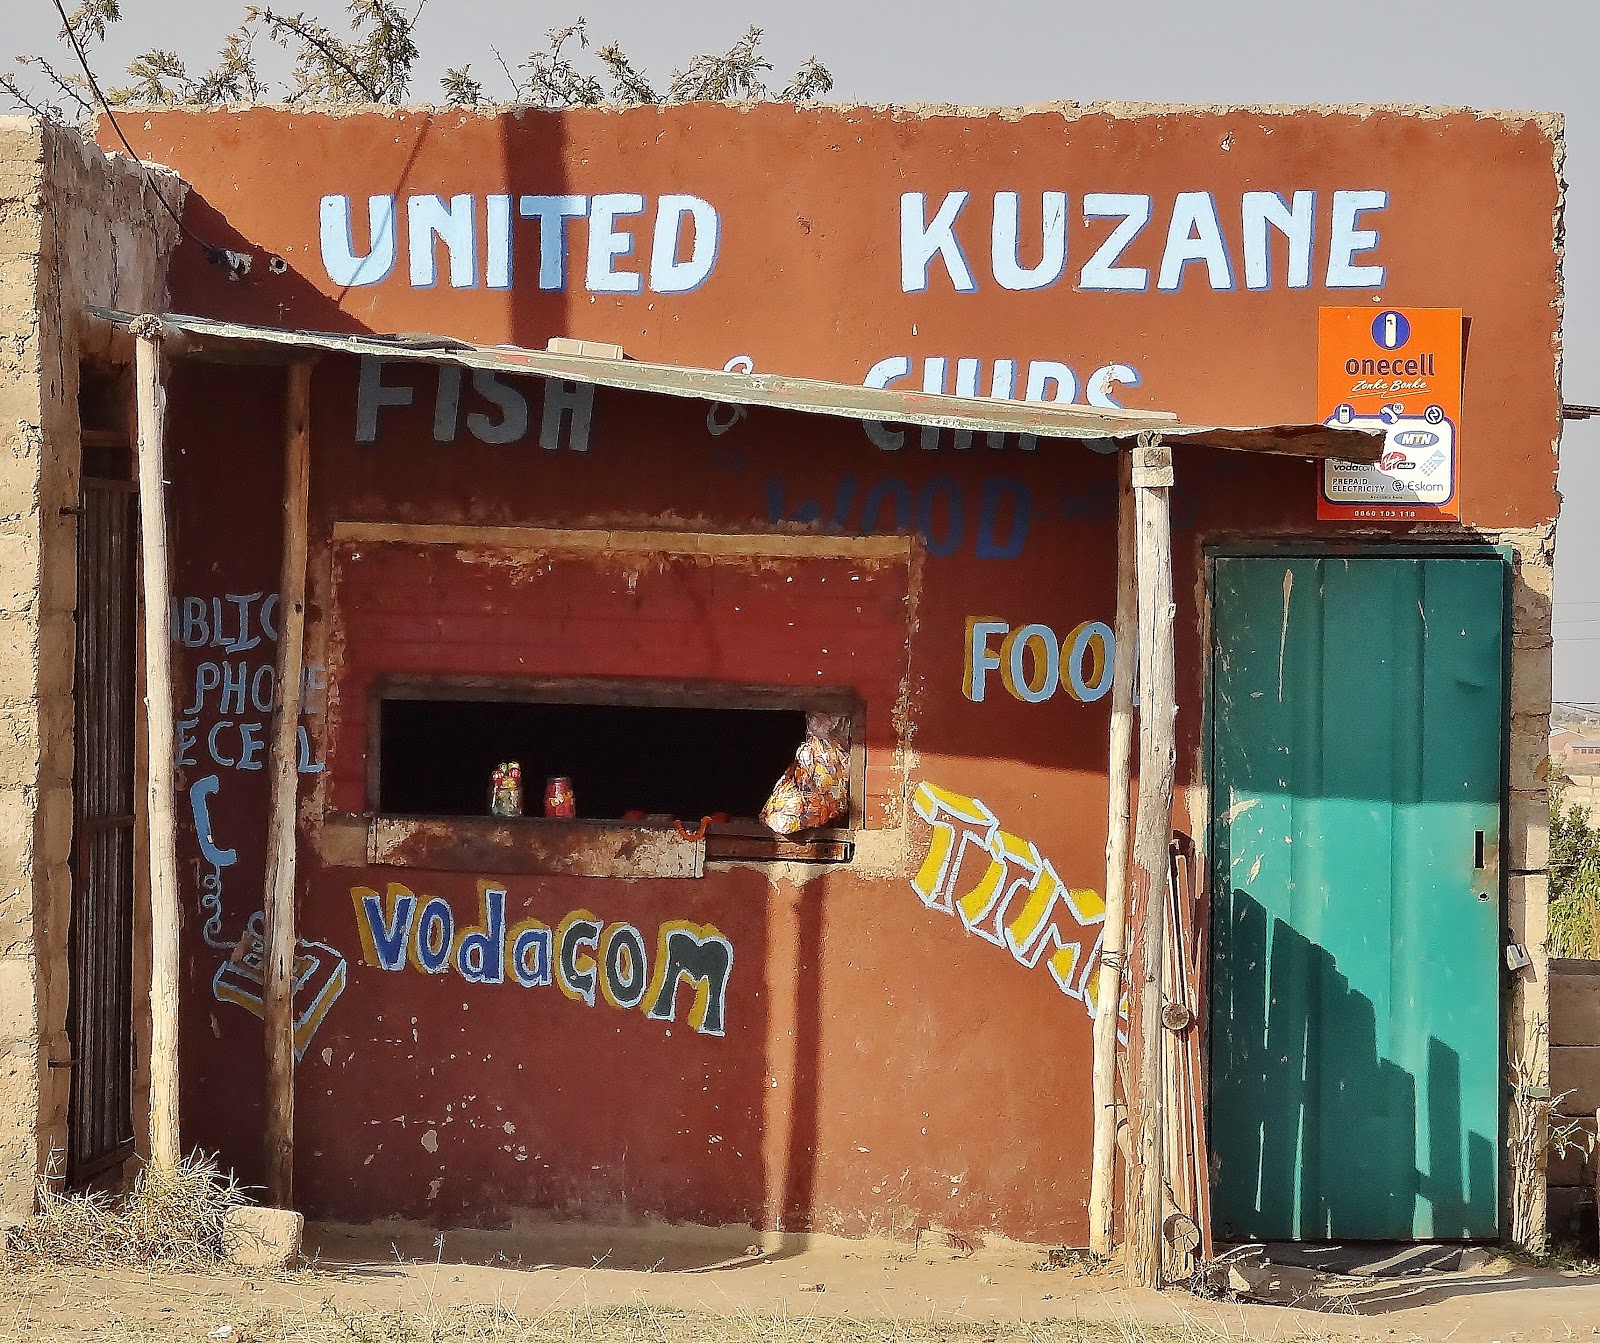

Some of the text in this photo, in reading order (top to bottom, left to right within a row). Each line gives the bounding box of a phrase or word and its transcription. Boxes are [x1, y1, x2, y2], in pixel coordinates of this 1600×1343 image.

[318, 190, 1388, 295] UNITED KUZANE
[1345, 353, 1435, 377] onecell
[1352, 377, 1428, 392] Zonke Bonke
[354, 354, 595, 452] FISH
[1401, 432, 1432, 446] MTN
[1332, 485, 1385, 493] ELECTRICITY
[1407, 480, 1444, 492] Eskom
[962, 615, 1140, 706] FOO
